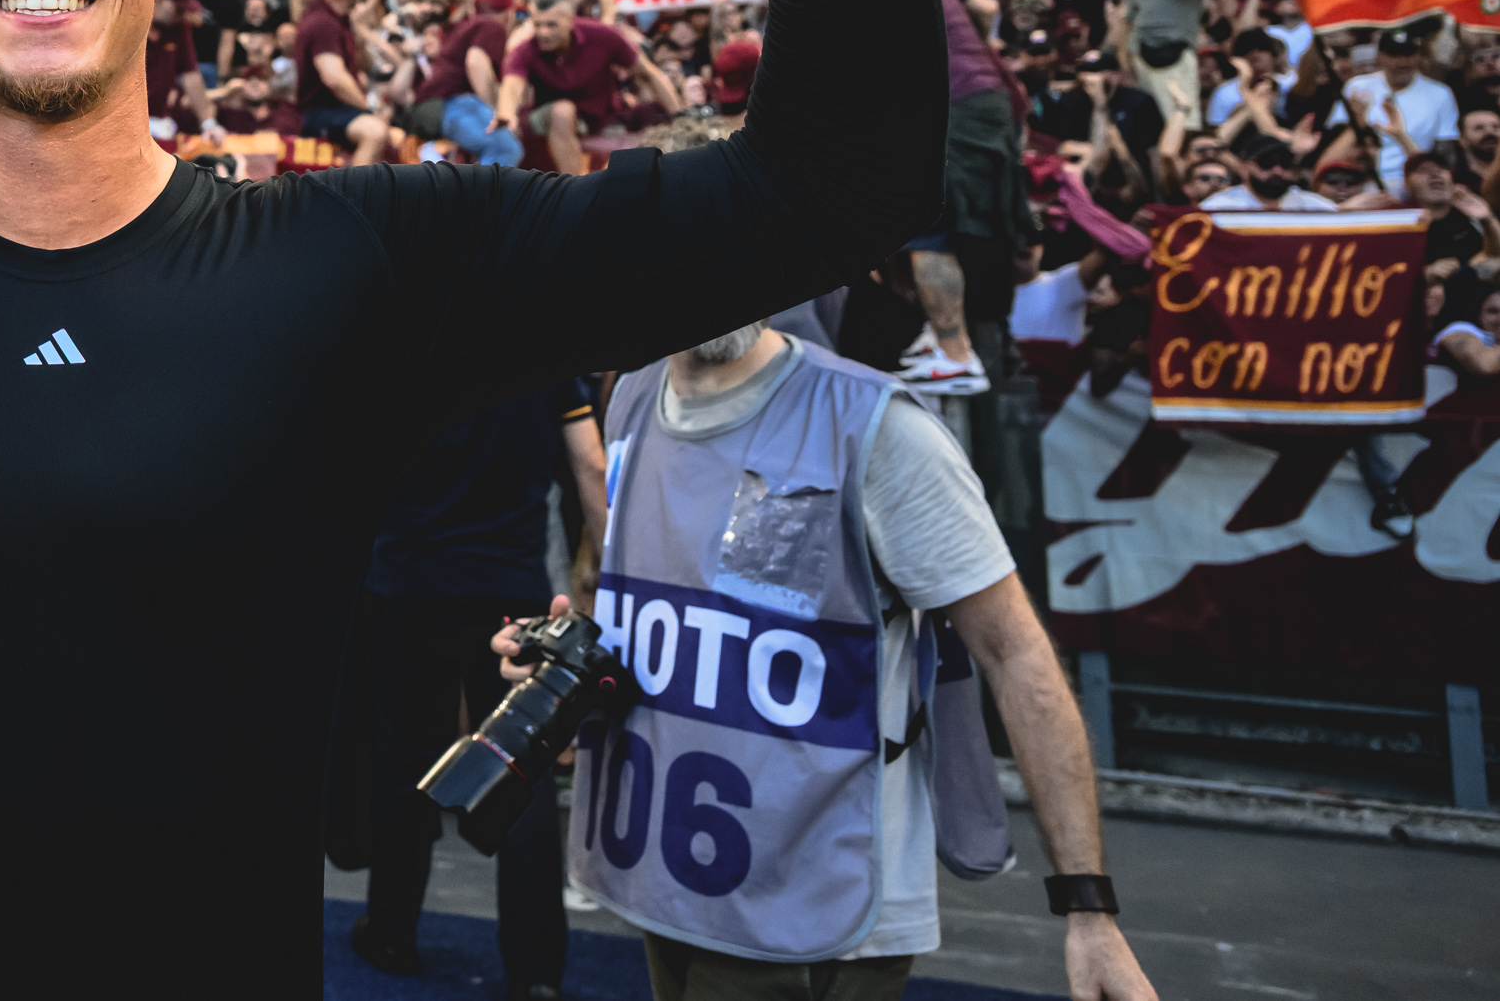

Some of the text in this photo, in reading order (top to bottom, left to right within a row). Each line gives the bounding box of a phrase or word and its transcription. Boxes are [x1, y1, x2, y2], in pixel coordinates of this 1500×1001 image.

[1150, 211, 1407, 322] Emilio
[1158, 319, 1402, 395] con noi
[577, 721, 753, 897] 106
